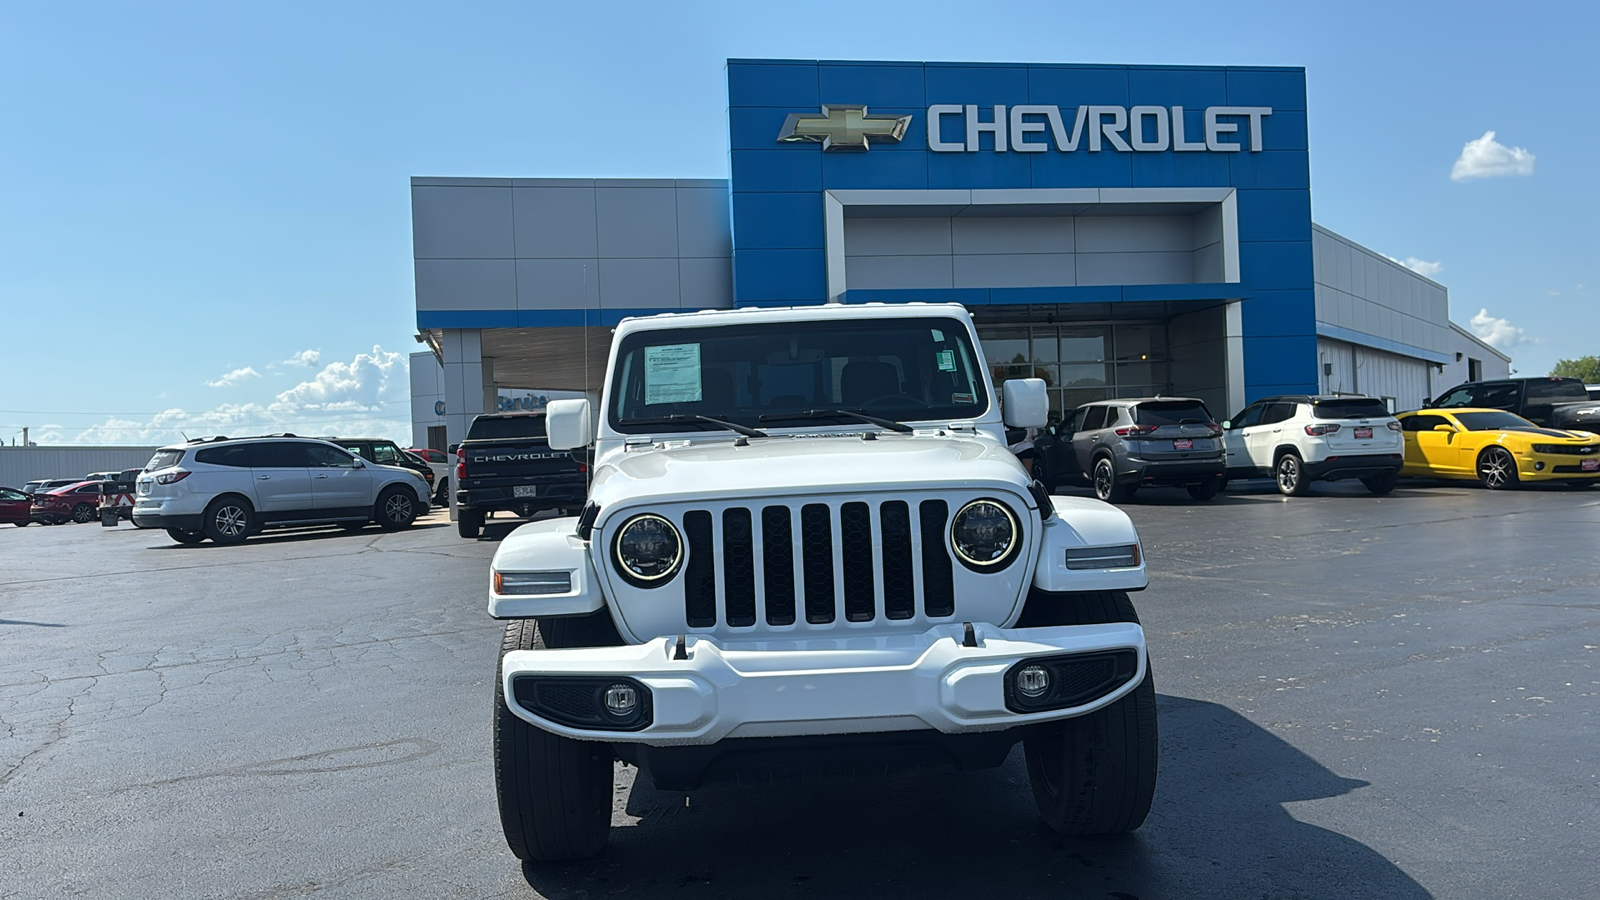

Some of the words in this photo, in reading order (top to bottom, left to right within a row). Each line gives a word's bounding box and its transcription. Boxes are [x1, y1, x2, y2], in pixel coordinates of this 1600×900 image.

[927, 104, 1272, 153] CHEVROLET
[498, 392, 547, 411] Service
[474, 452, 570, 463] CHEVROLET
